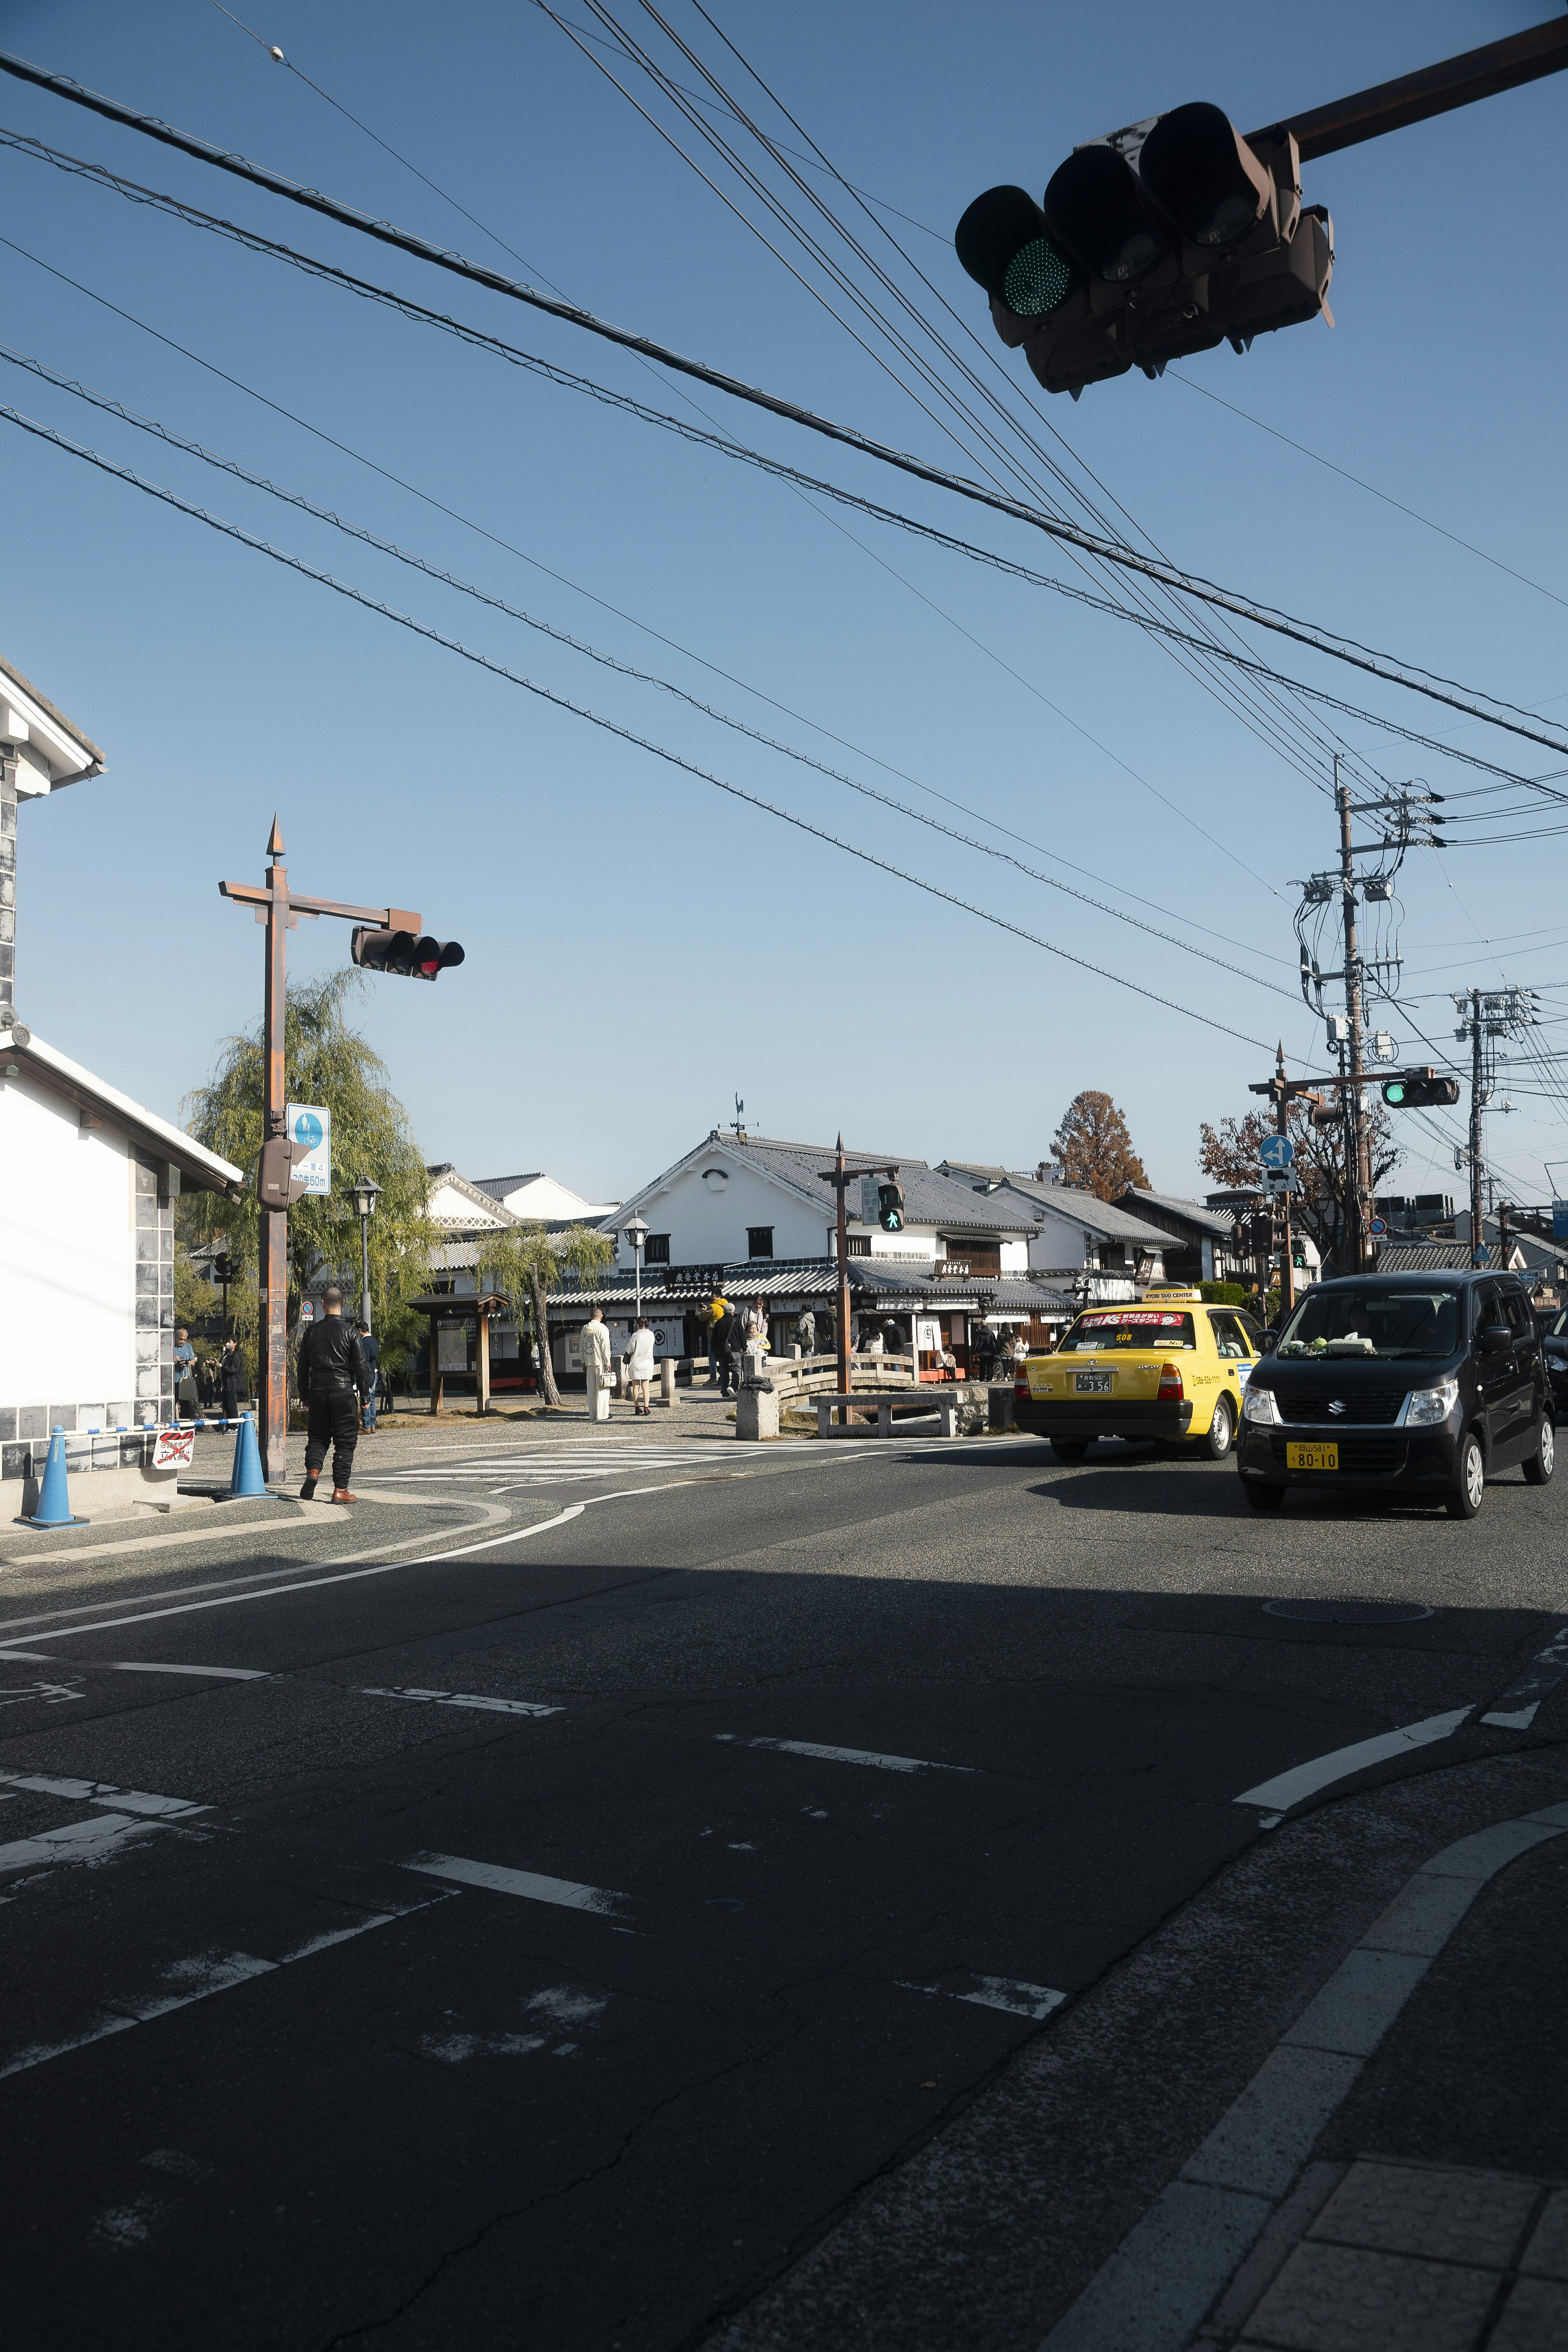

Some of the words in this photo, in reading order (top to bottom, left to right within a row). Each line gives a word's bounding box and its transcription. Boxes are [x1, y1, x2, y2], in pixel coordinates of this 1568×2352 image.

[1101, 1314, 1123, 1325] K's
[1196, 1375, 1221, 1384] 086-526-1111
[1298, 1444, 1325, 1452] 岡山581
[159, 1450, 190, 1461] 立入禁止
[1298, 1453, 1335, 1467] 80-10
